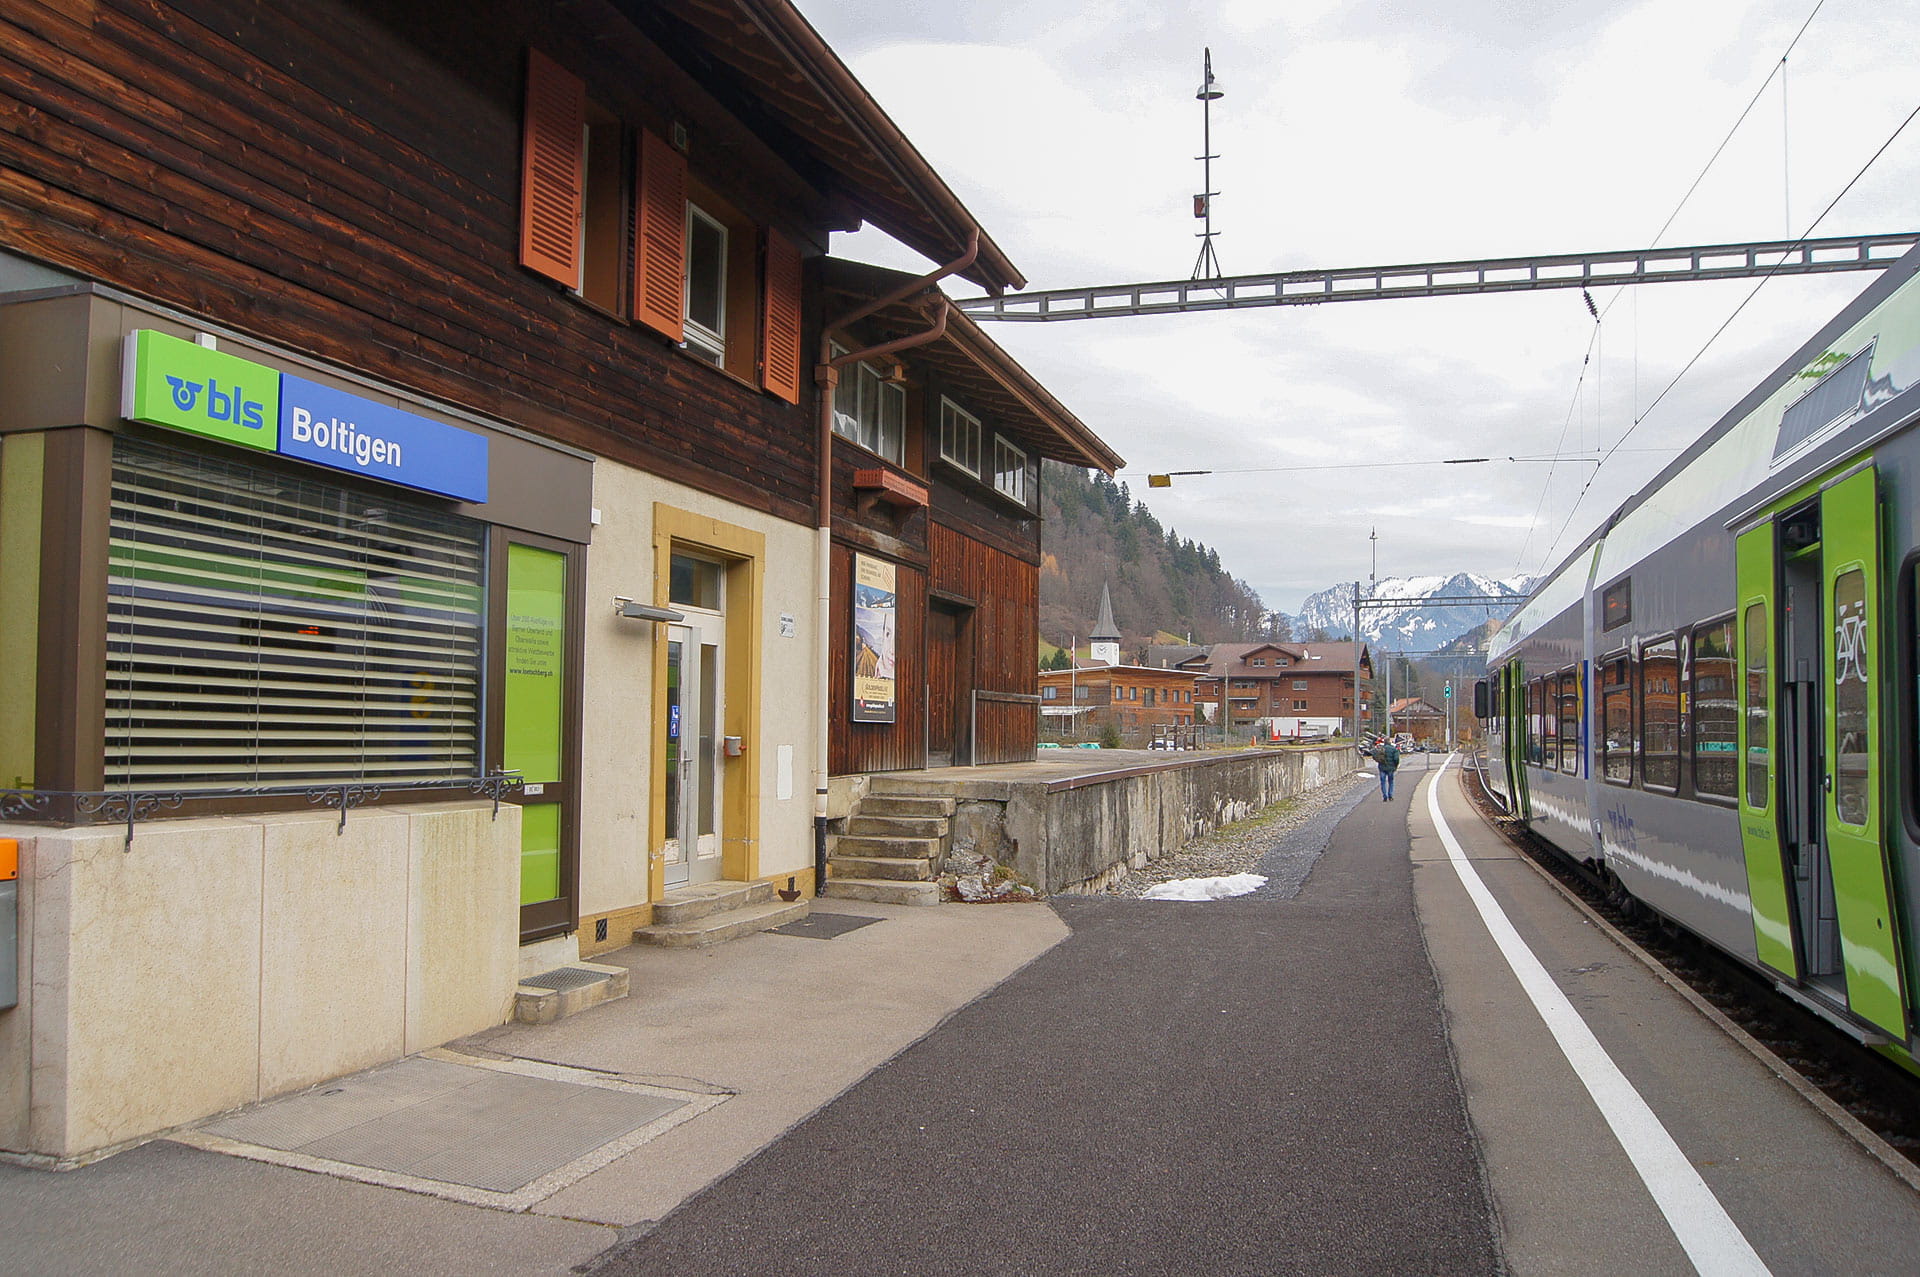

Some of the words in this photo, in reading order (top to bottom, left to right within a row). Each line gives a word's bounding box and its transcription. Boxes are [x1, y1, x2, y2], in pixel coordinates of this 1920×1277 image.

[207, 378, 263, 430] bls
[292, 406, 401, 466] Boltigen
[1681, 635, 1689, 681] 2
